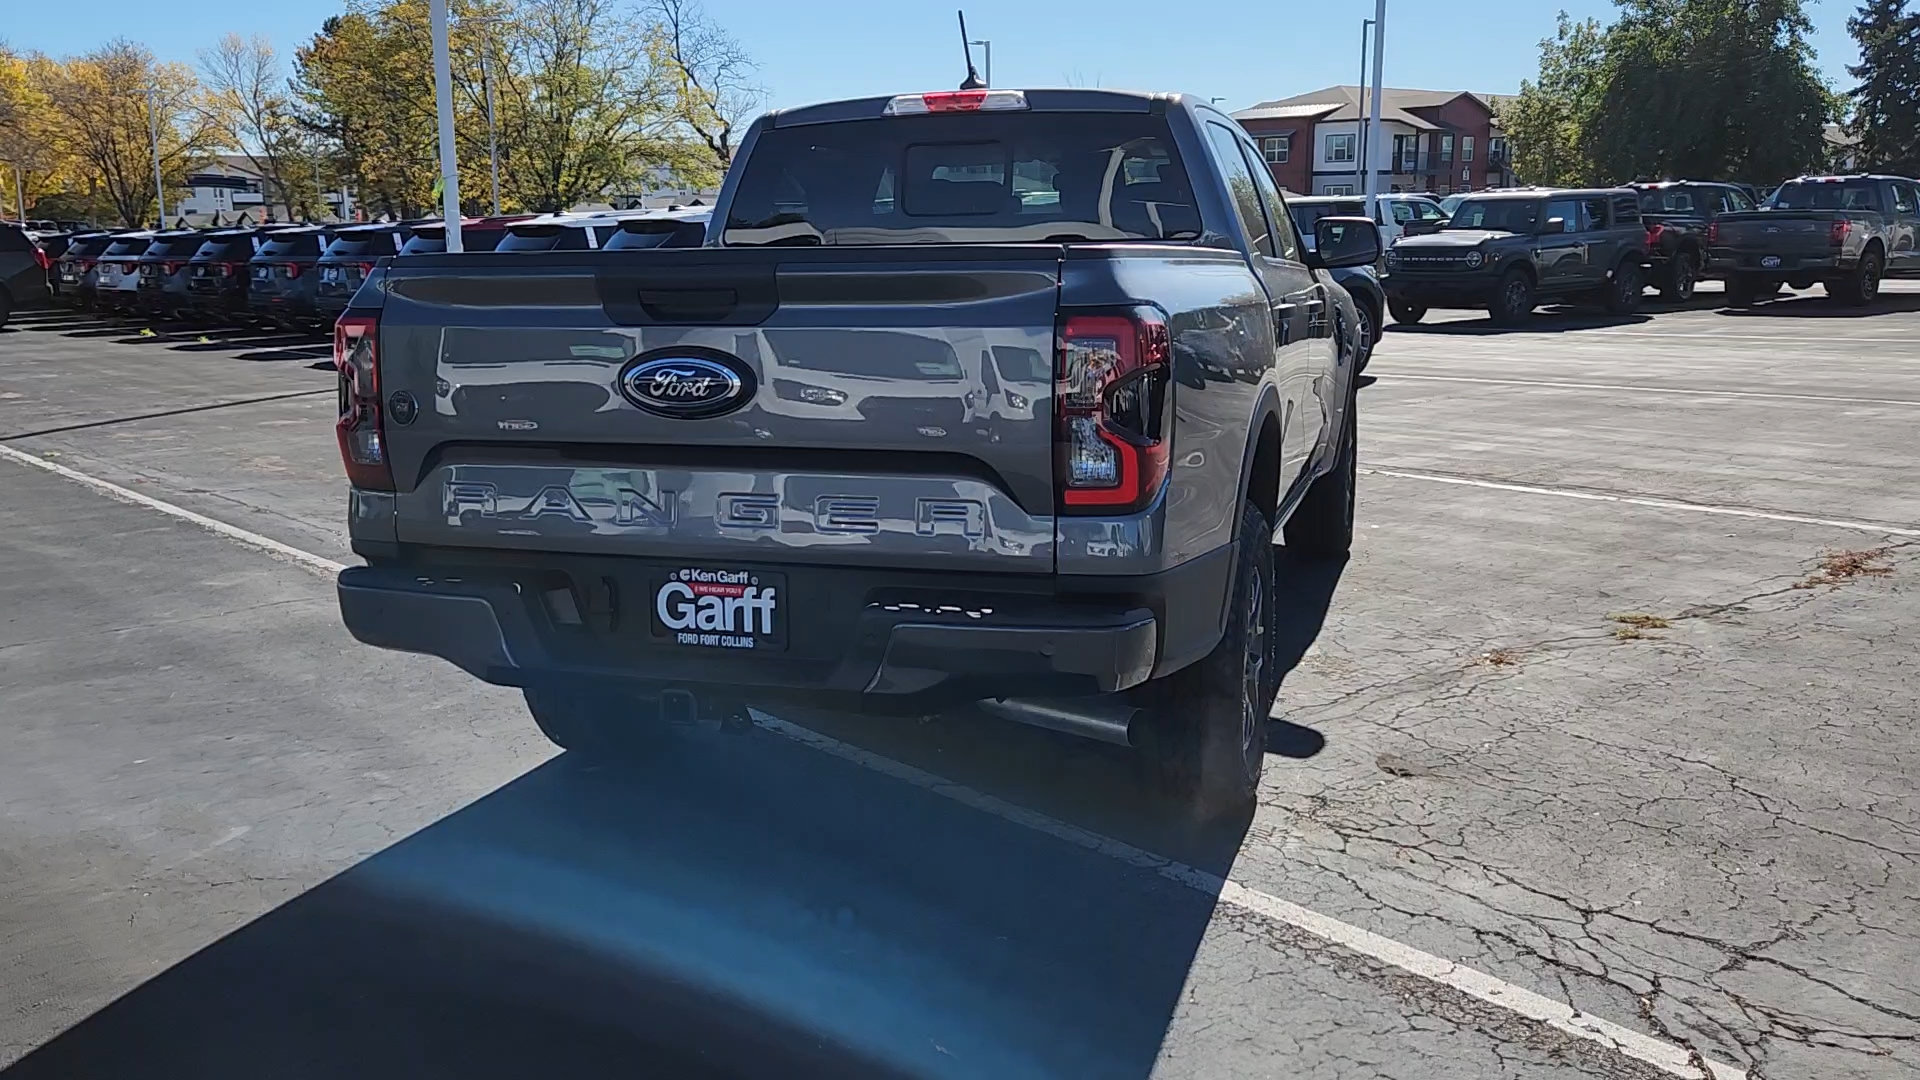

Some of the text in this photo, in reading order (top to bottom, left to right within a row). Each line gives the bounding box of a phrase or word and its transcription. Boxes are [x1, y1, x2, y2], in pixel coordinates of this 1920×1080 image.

[650, 368, 710, 397] Ford
[442, 480, 986, 539] RANGER
[691, 568, 748, 585] Ken Garff
[708, 586, 725, 594] HEAR
[657, 581, 776, 634] Garff
[677, 632, 754, 648] FORD FORT COLLINS
